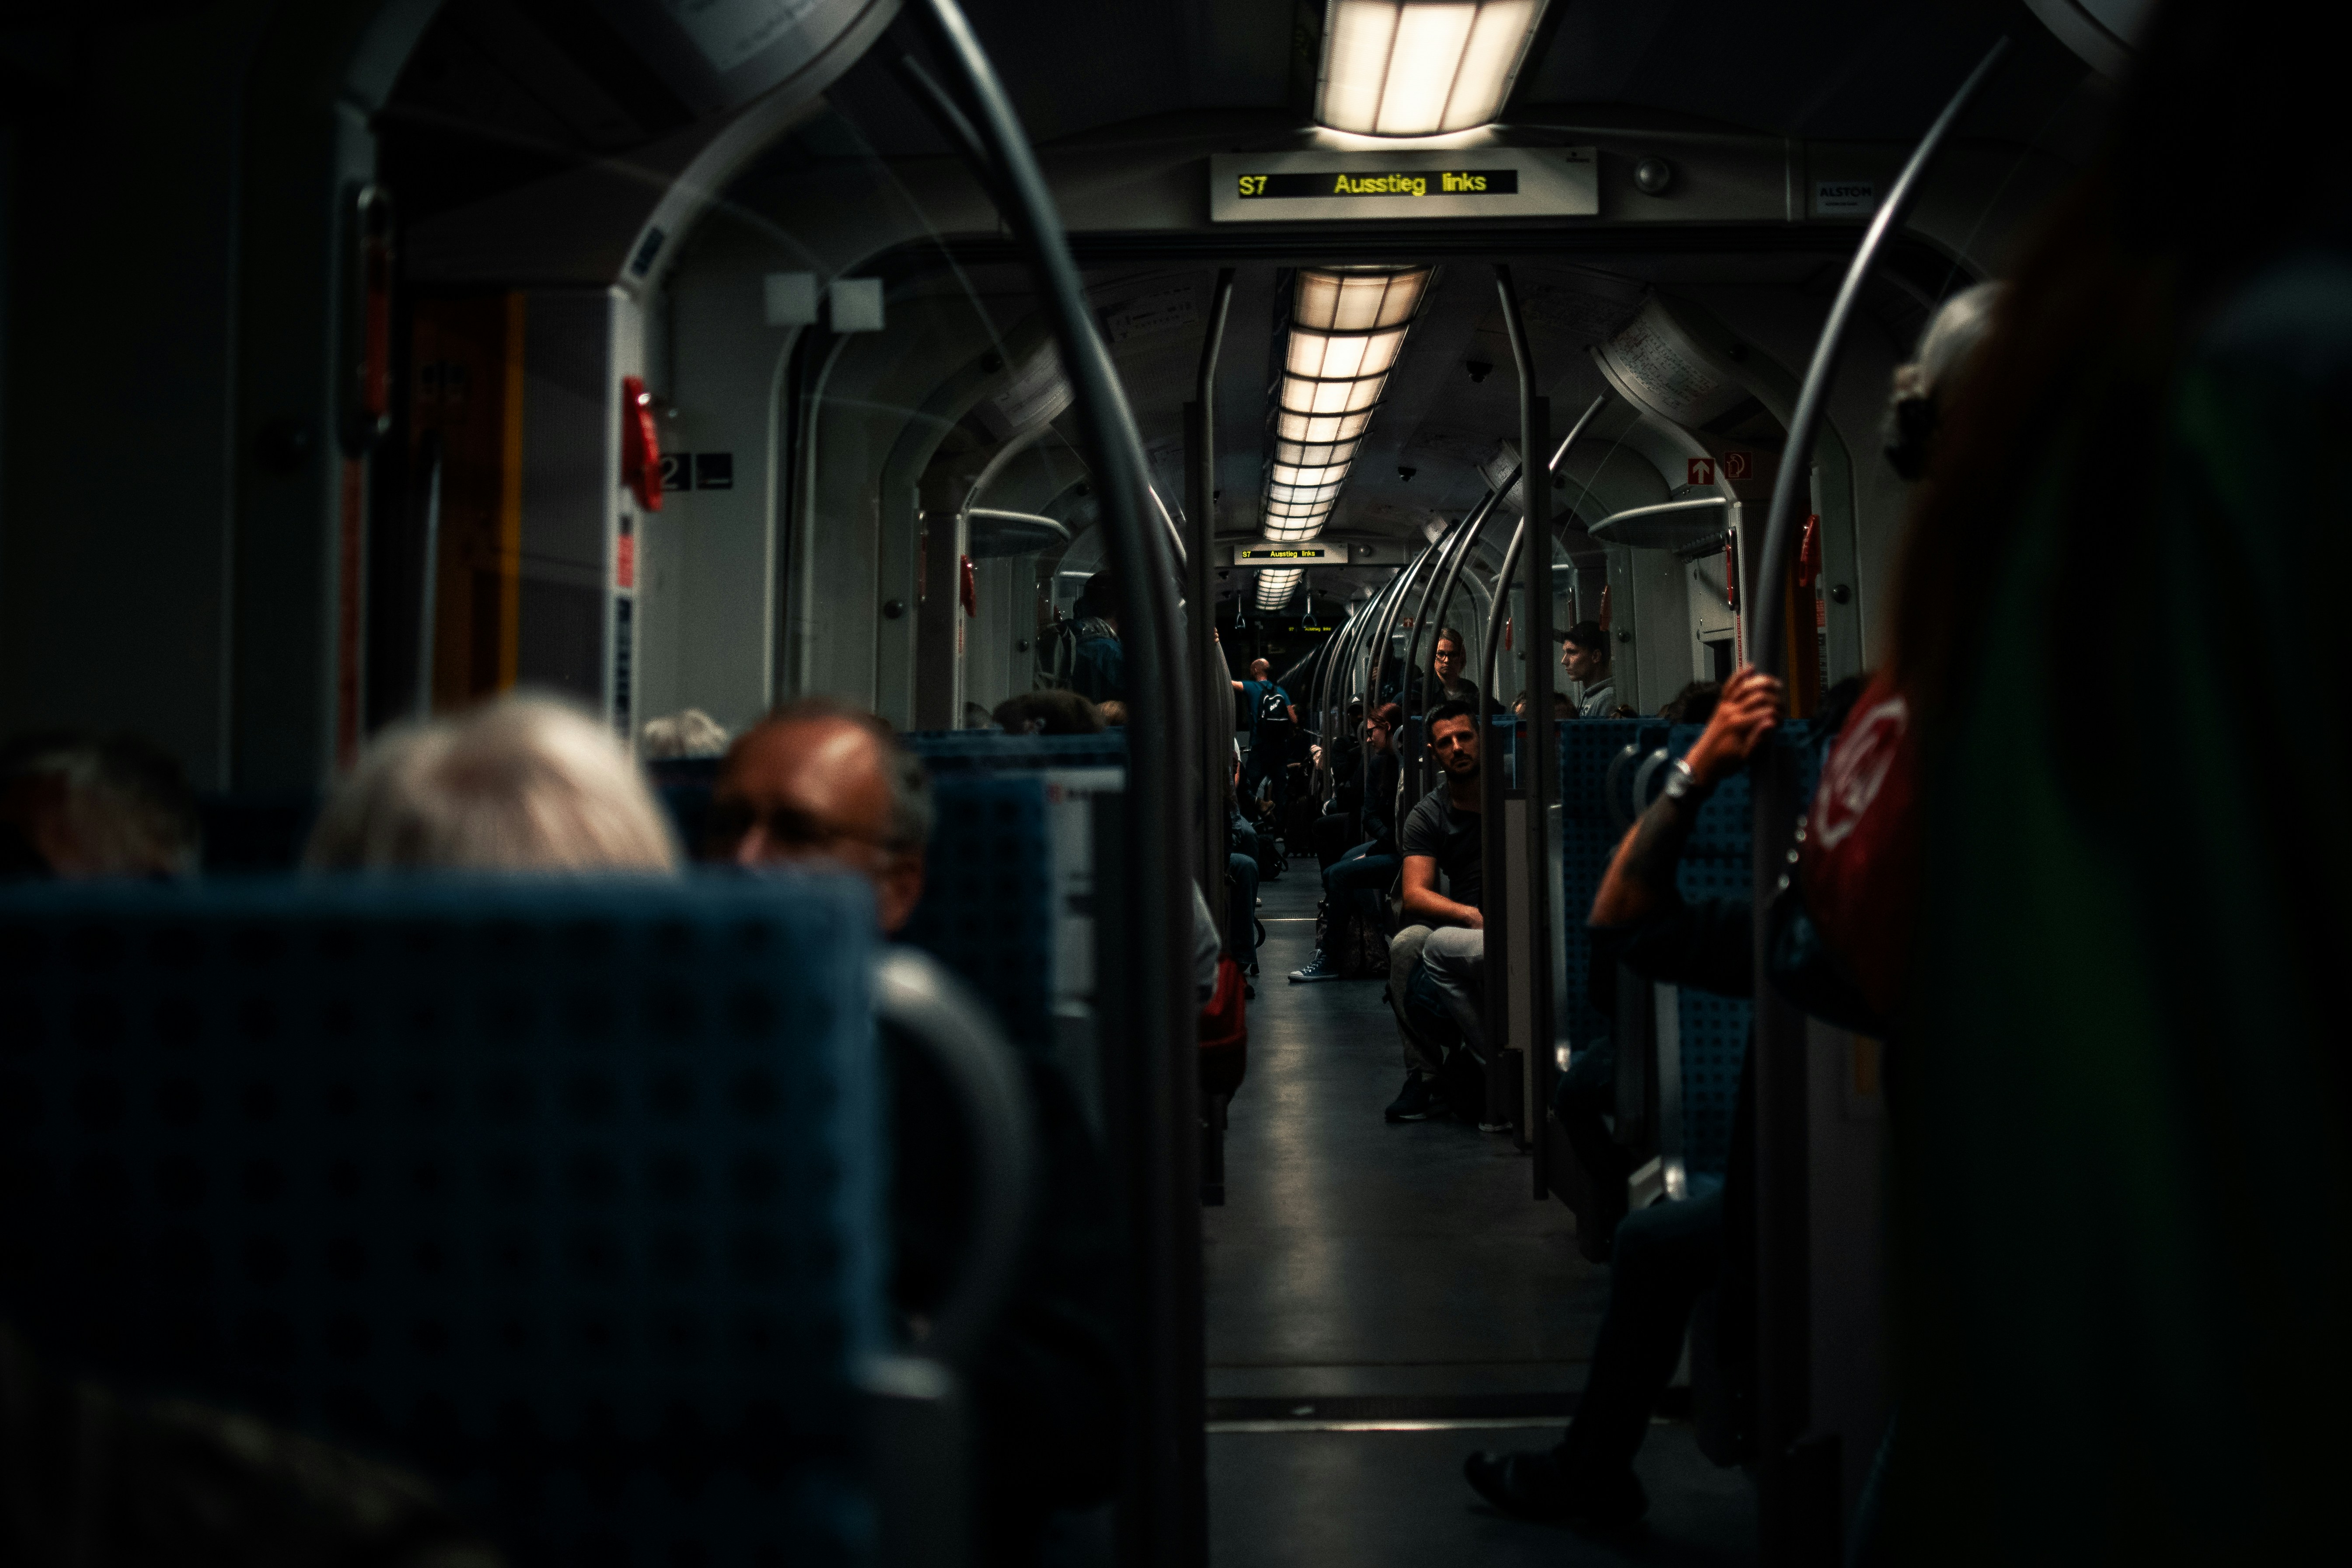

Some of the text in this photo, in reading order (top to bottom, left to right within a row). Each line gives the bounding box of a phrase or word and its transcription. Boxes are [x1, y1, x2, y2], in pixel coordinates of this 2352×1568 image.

[1239, 172, 1487, 196] S7 Ausstieg links
[1820, 187, 1871, 197] ALSTOM
[660, 456, 679, 489] 2
